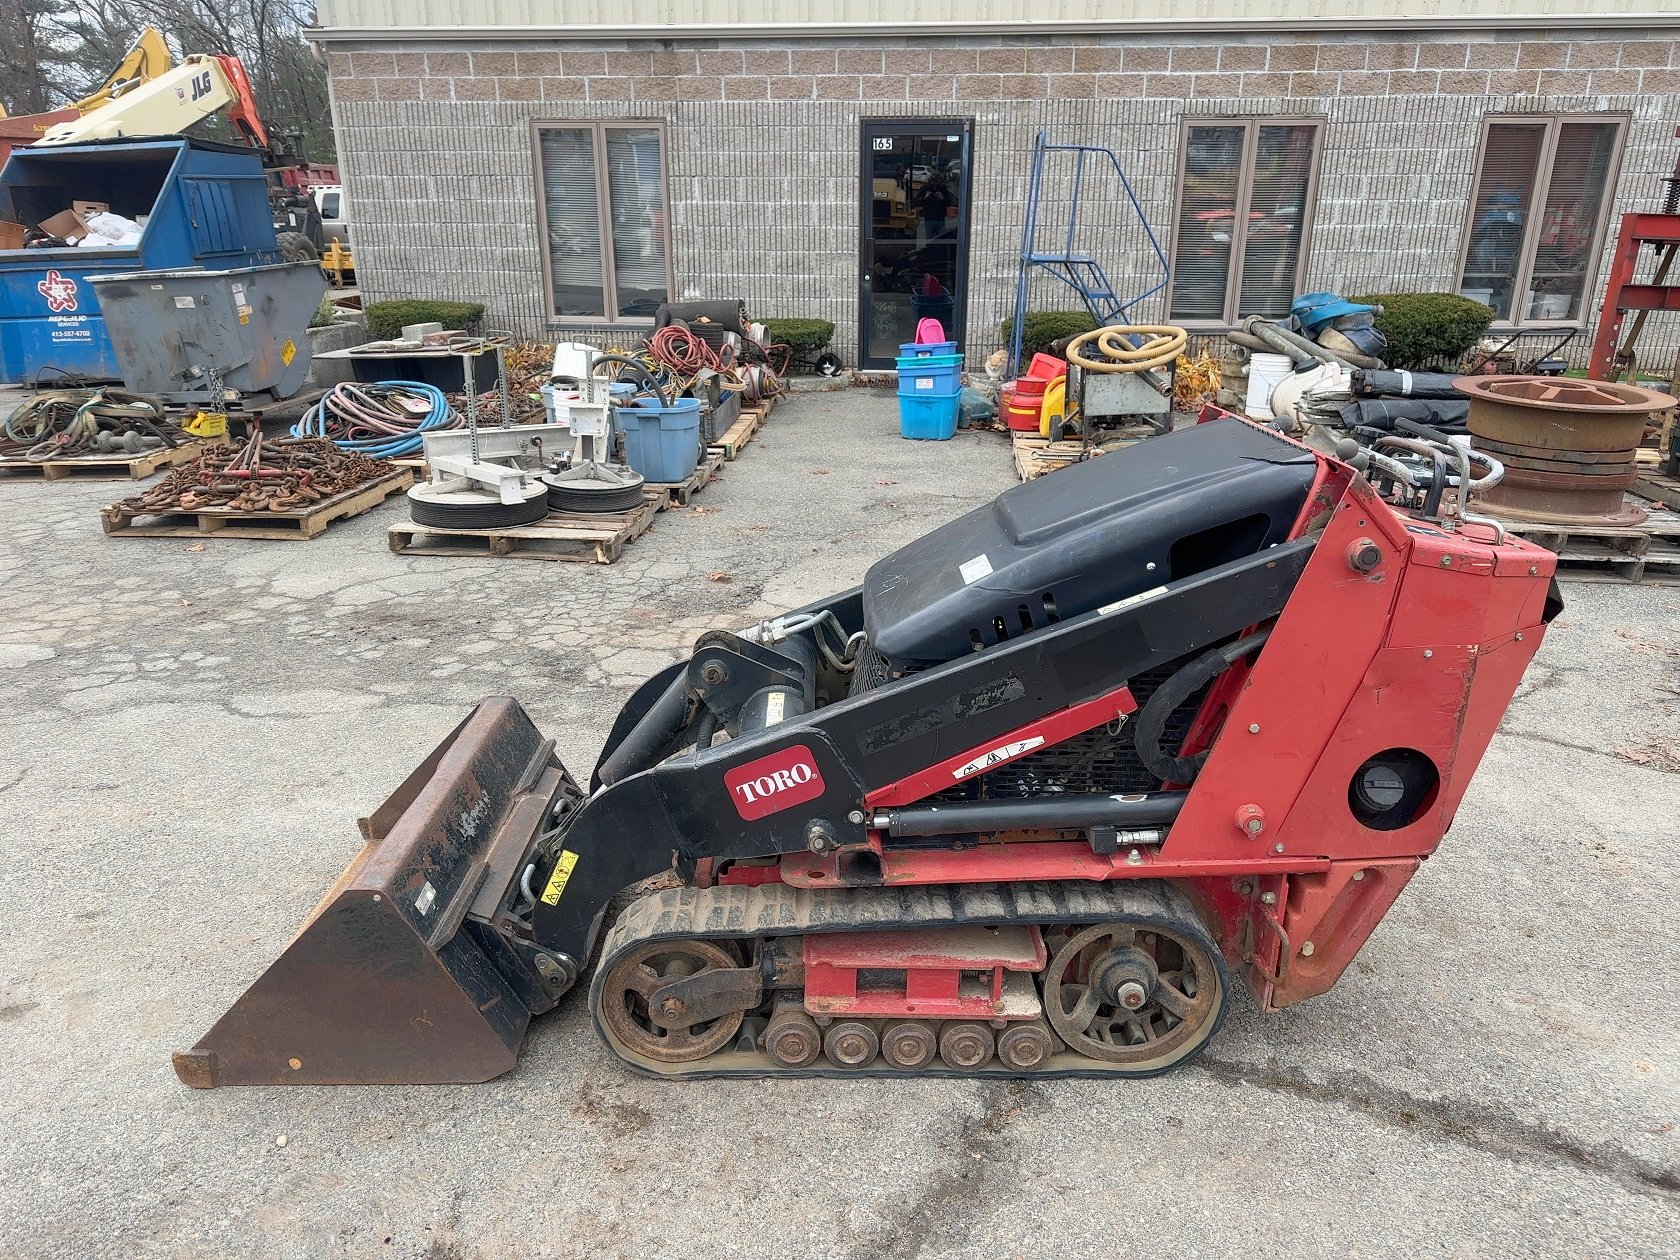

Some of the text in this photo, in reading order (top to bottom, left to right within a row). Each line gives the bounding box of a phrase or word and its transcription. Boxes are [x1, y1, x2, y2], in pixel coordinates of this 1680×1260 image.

[192, 71, 211, 101] JLG
[874, 138, 891, 149] 165
[735, 763, 812, 804] TORO
